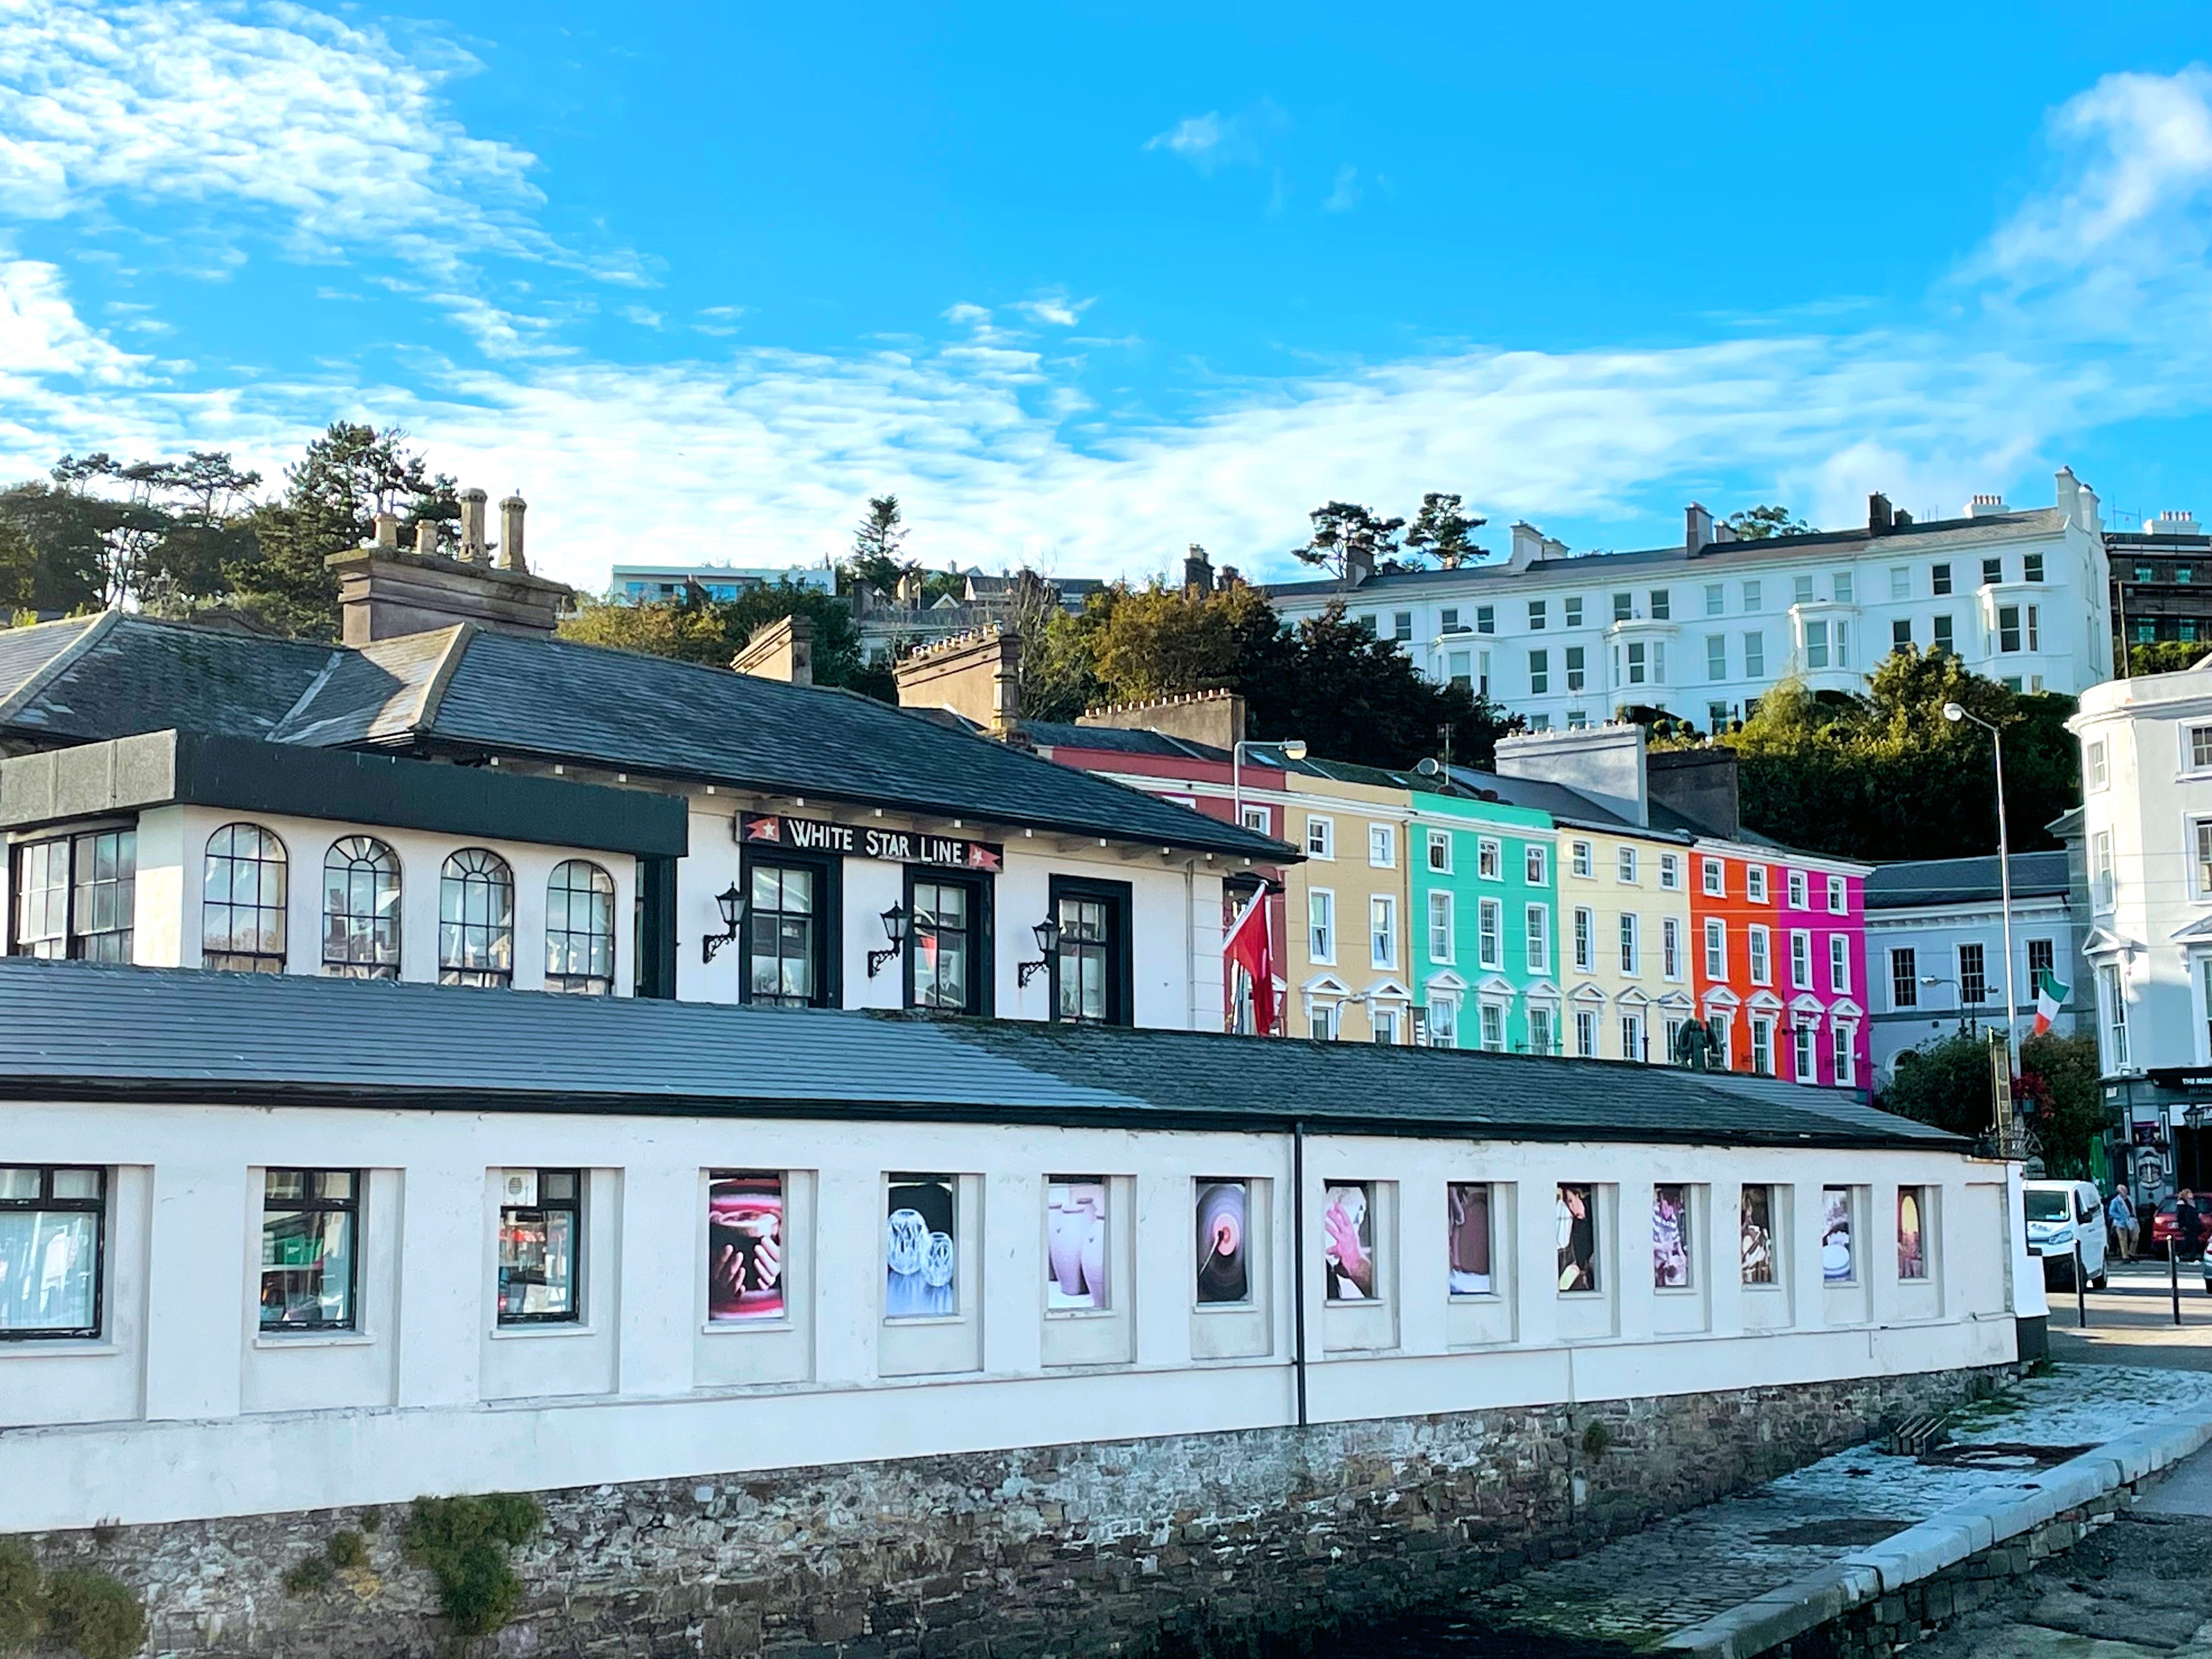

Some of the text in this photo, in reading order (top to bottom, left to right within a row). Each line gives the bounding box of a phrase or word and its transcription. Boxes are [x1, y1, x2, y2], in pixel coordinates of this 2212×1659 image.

[788, 820, 962, 864] WHITE STAR LINE
